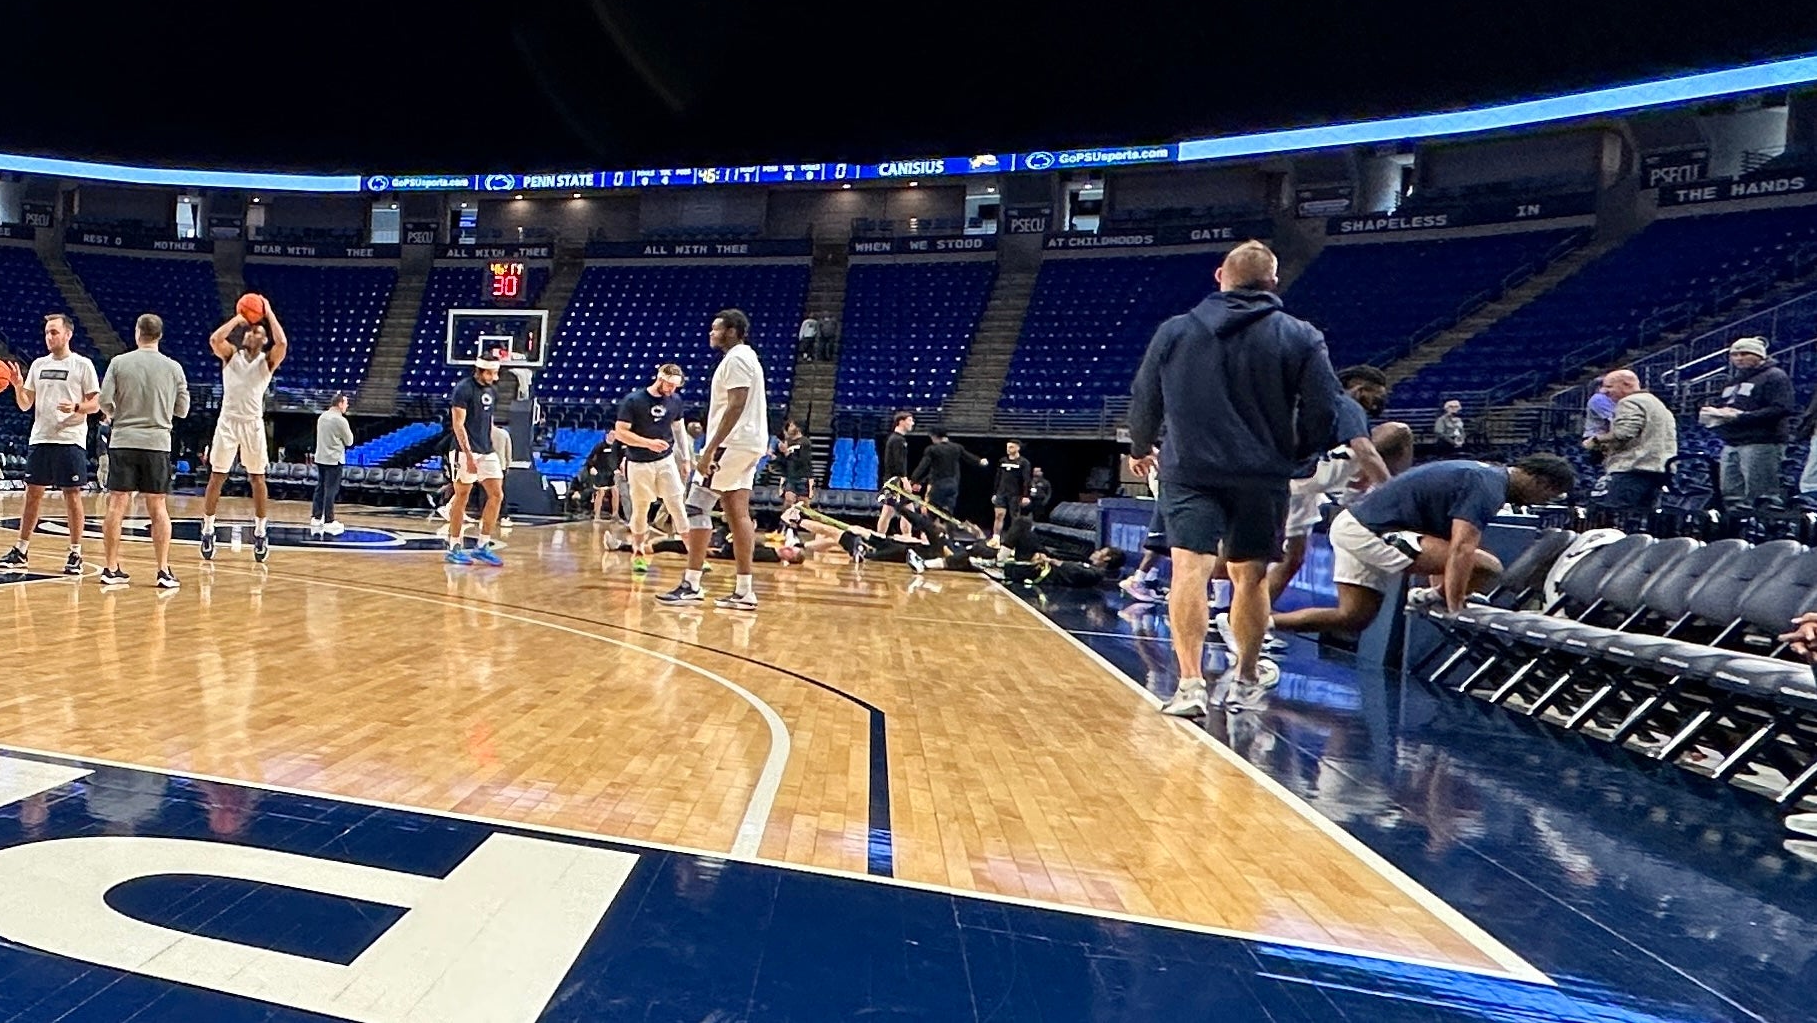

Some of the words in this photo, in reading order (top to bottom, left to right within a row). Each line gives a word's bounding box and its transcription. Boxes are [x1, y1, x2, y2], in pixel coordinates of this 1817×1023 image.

[522, 174, 556, 188] PENN
[557, 173, 595, 187] STATE
[613, 173, 624, 187] 0
[834, 163, 848, 180] 0
[877, 159, 945, 178] CANISIUS
[1675, 185, 1718, 203] THE
[1731, 176, 1806, 197] HANDS
[1515, 203, 1540, 218] IN
[1010, 217, 1046, 234] PSECU
[1339, 213, 1449, 234] SHAPELESS
[82, 233, 110, 246] REST
[153, 240, 197, 252] MOTHER
[406, 230, 434, 244] PSECU
[854, 241, 892, 253] WHEN
[909, 240, 928, 252] WE
[935, 238, 983, 251] STOOD
[1047, 237, 1065, 248] AT
[1190, 227, 1233, 241] GATE
[286, 246, 316, 257] WITH
[345, 247, 375, 258] THEE
[445, 248, 469, 259] ALL
[518, 246, 549, 258] THEE
[643, 244, 668, 255] ALL
[674, 244, 709, 255] WITH
[715, 243, 749, 254] THEE
[492, 275, 519, 296] 30
